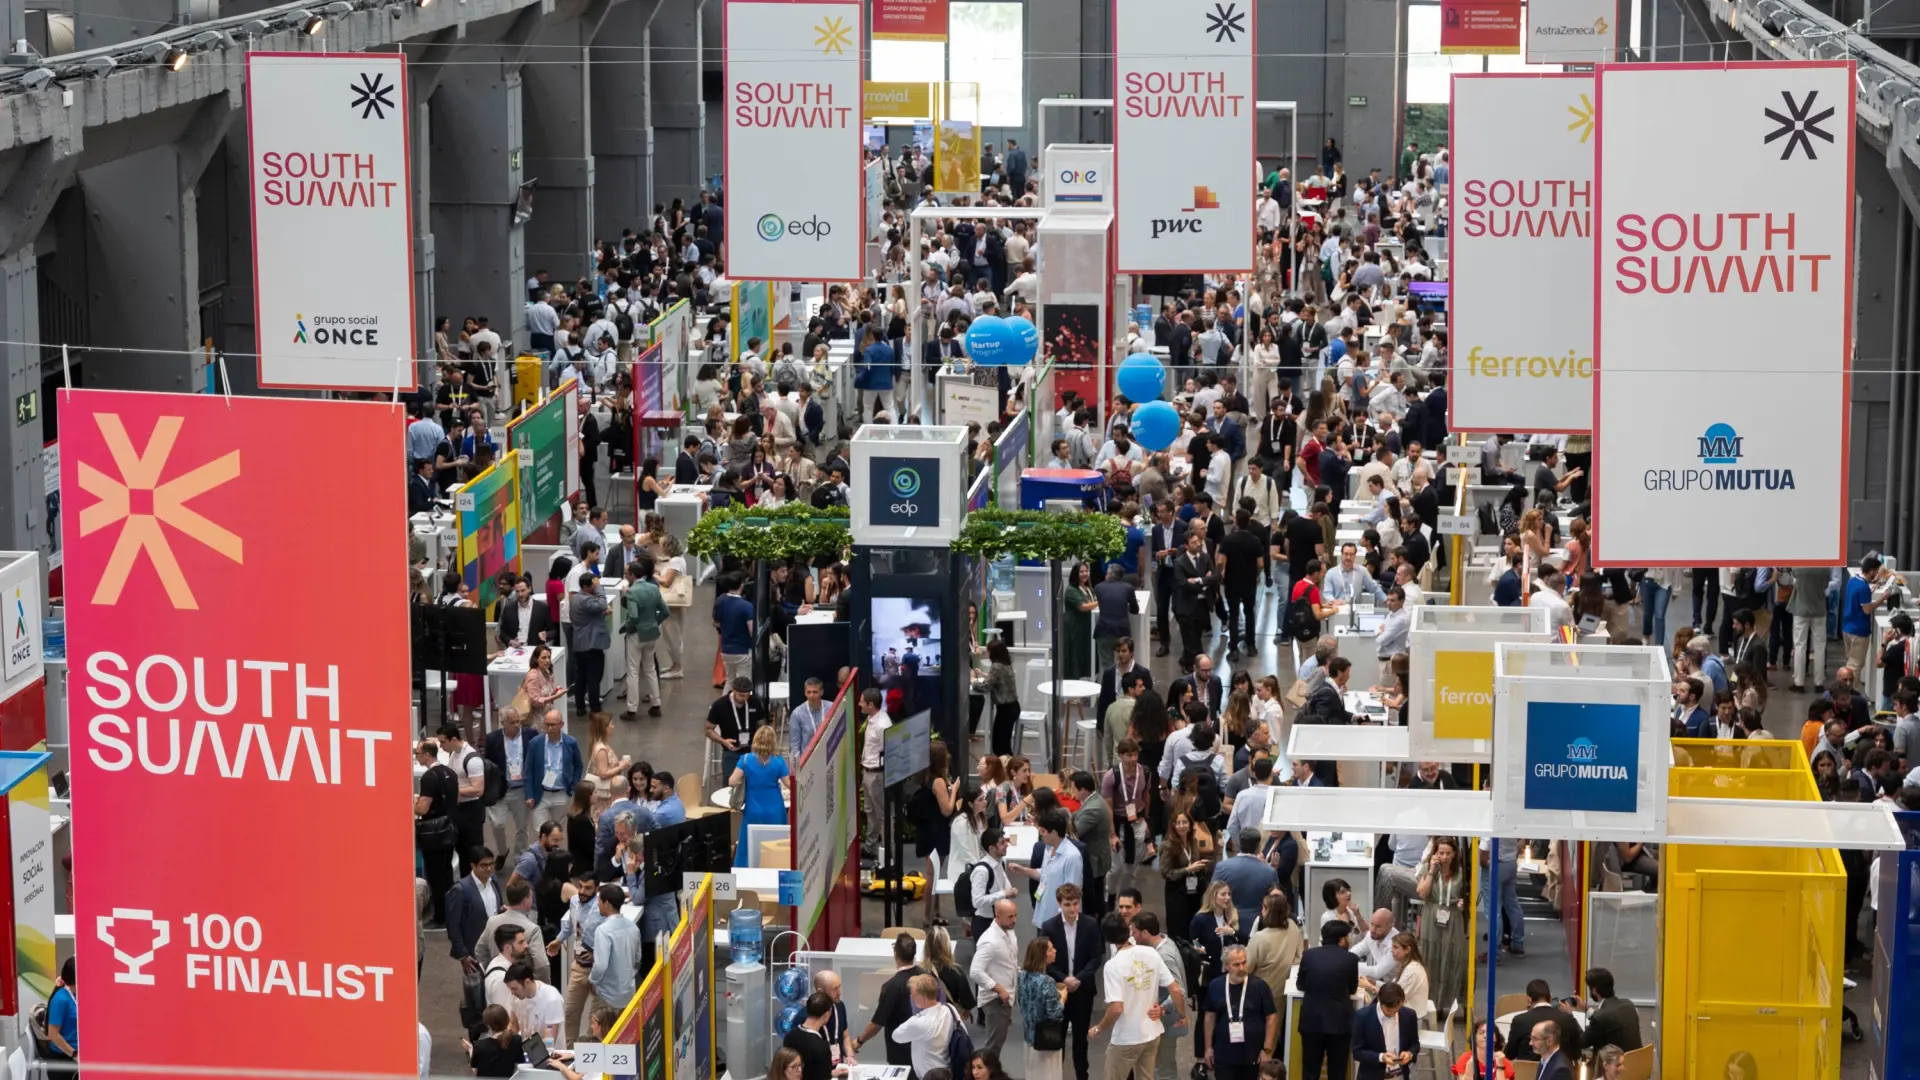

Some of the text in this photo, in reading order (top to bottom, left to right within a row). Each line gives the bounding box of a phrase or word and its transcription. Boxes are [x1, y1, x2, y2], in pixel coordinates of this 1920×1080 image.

[1536, 26, 1595, 35] AstraZeneca
[736, 82, 832, 104] SOUTH
[1126, 72, 1224, 94] SOUTH
[865, 88, 909, 102] rrovial
[736, 106, 852, 128] SUMMIT
[1126, 96, 1244, 117] SUMMIT
[263, 152, 374, 179] SOUTH
[264, 180, 396, 207] SUMMIT
[1464, 180, 1591, 207] SOUTH
[788, 214, 831, 241] edp
[1151, 219, 1202, 238] pwc
[1464, 210, 1591, 237] SUMMI
[1616, 213, 1795, 252] SOUTH
[1616, 255, 1831, 294] SUMMIT
[313, 315, 378, 327] grupo social
[314, 328, 378, 345] ONCE
[971, 341, 1000, 349] Startup
[1468, 346, 1592, 378] ferrovia
[890, 500, 918, 517] edp
[12, 645, 31, 665] ONCE
[86, 652, 339, 722] SOUTH
[1440, 686, 1492, 705] ferrov
[88, 714, 392, 786] SUMMIT
[23, 861, 44, 884] SOCIAL
[24, 884, 44, 905] PERSONAS
[716, 882, 730, 891] 26
[183, 913, 262, 952] 100
[187, 954, 393, 1001] FINALIST
[583, 1053, 628, 1065] 27 23
